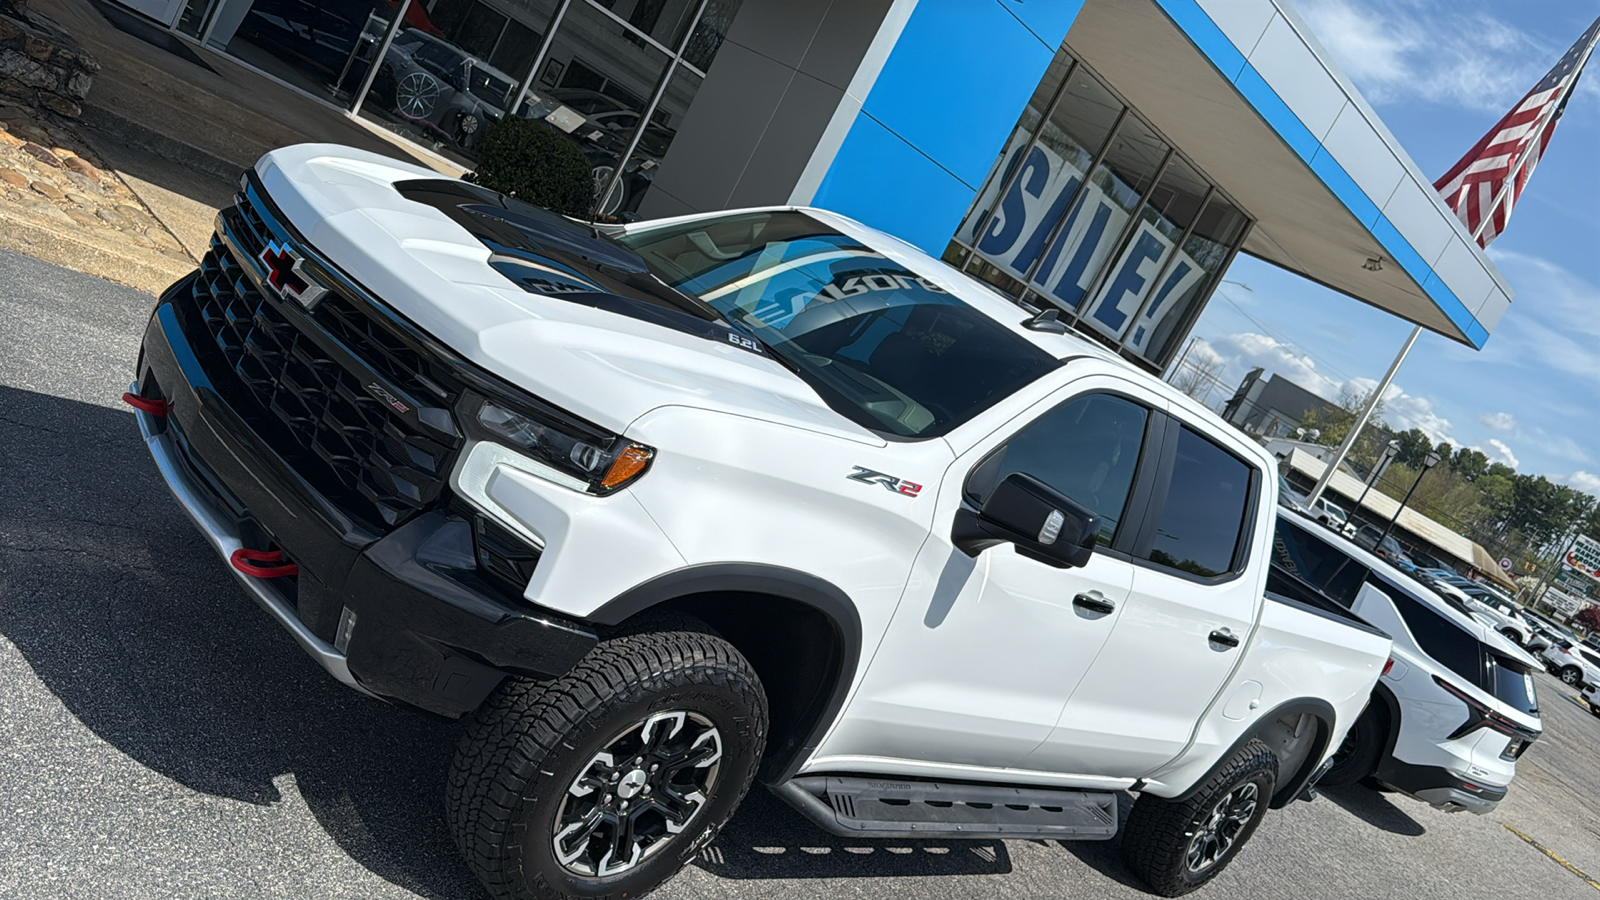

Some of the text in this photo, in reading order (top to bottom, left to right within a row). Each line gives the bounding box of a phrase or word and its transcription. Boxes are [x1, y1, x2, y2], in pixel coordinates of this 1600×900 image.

[972, 144, 1191, 347] SALE!
[368, 382, 410, 413] ZR2
[845, 465, 923, 498] ZR2
